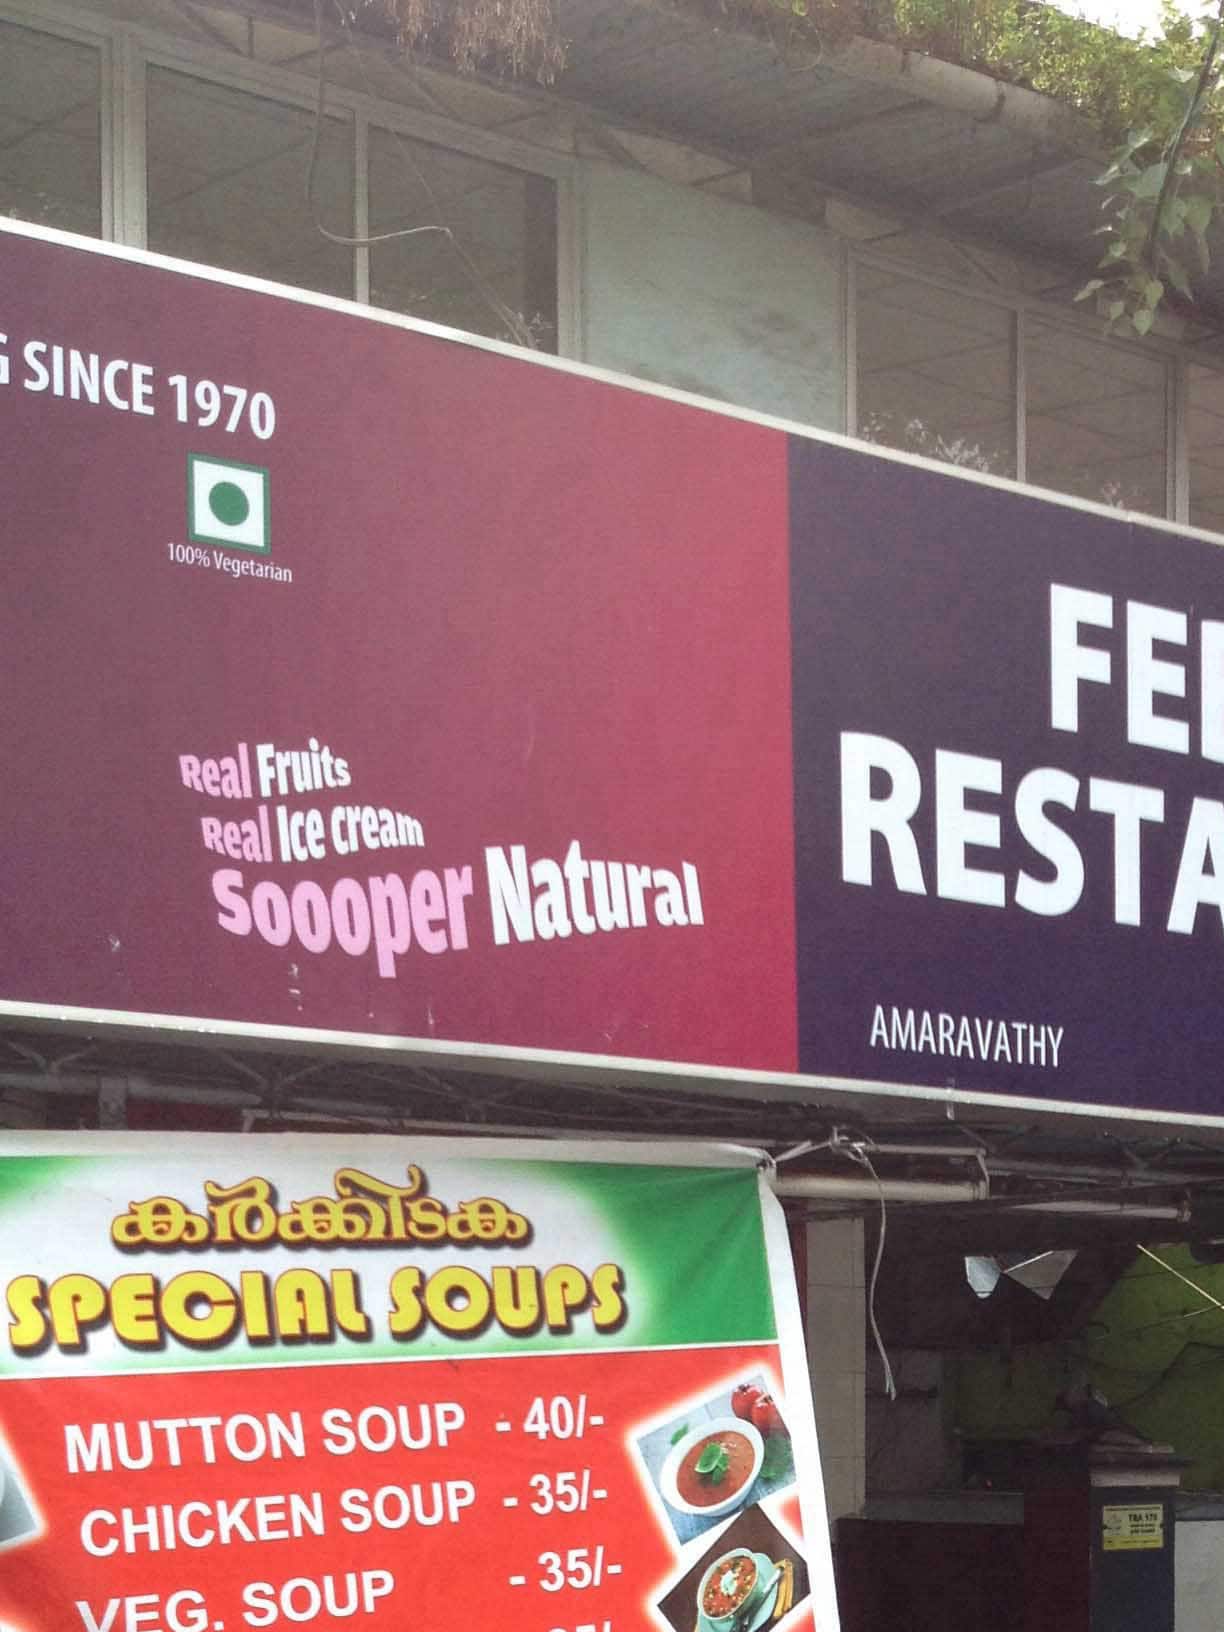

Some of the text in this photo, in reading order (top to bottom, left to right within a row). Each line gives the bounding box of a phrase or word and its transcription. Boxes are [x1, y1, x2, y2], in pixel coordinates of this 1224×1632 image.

[23, 340, 155, 416] SINCE
[167, 374, 276, 440] 1970
[167, 543, 293, 583] 100% Vegetarian
[179, 737, 352, 799] Real Fruits
[201, 805, 425, 863] Real Ice cream
[212, 839, 705, 978] Soooper Natural
[870, 1004, 1064, 1067] AMARAVATHY
[5, 1262, 629, 1354] SPECIAL SOUPS
[63, 1411, 306, 1474] MUTTON
[321, 1402, 466, 1455] SOUP
[80, 1491, 325, 1557] CHICKEN
[340, 1480, 476, 1533] SOUP
[242, 1569, 395, 1627] SOUP
